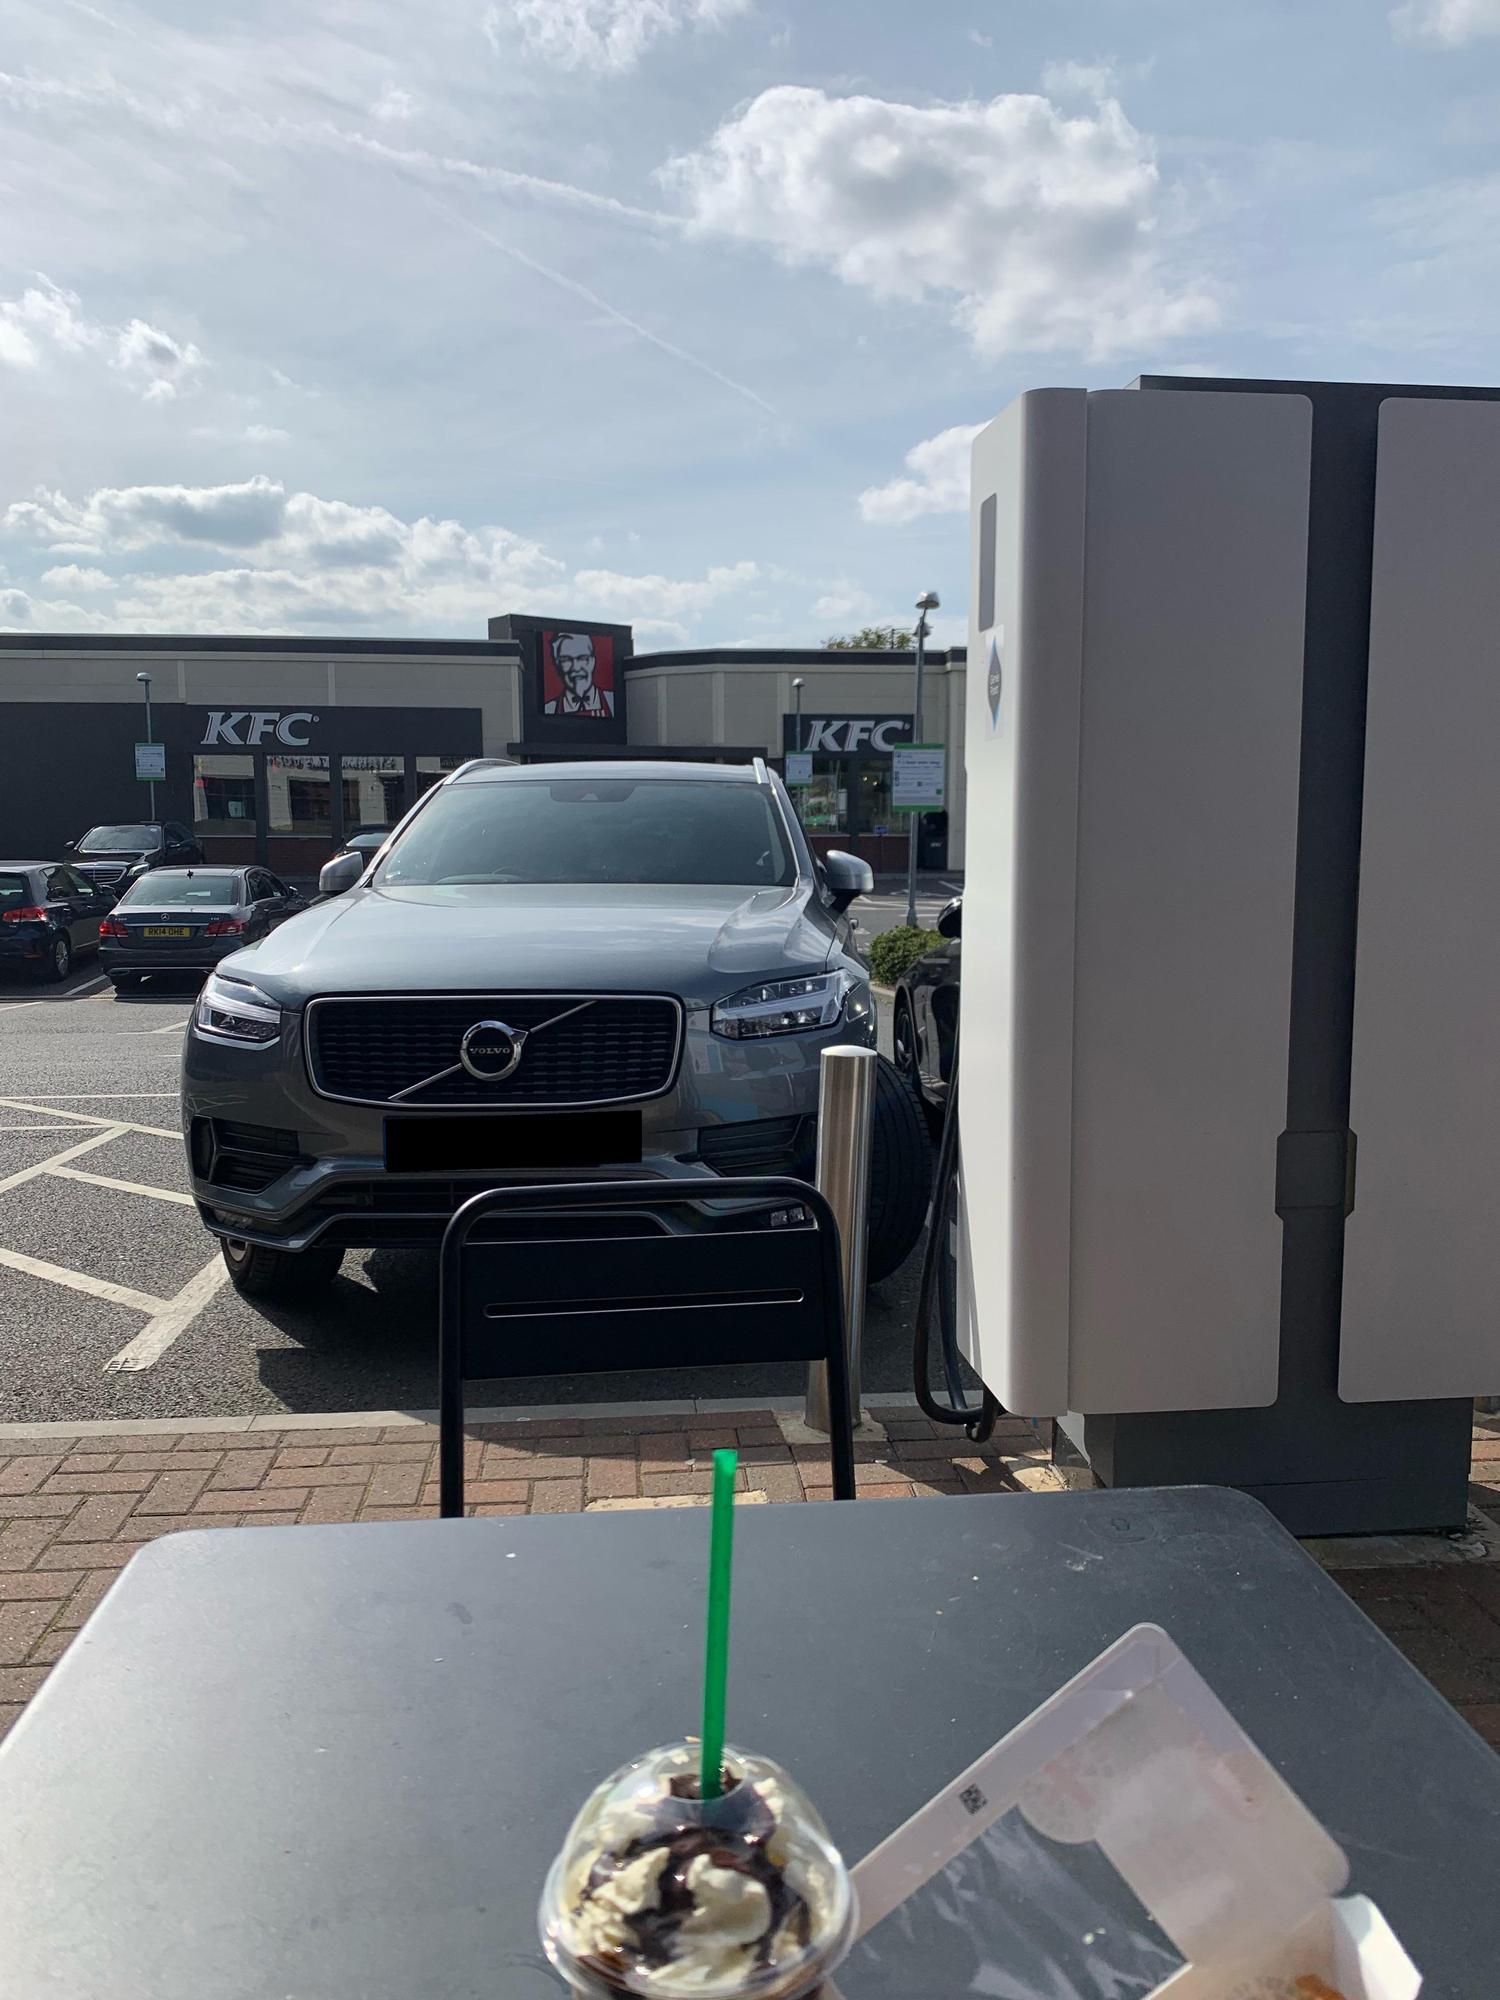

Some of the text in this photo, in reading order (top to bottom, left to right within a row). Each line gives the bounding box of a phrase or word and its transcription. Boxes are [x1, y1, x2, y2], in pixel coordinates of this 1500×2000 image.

[200, 712, 313, 746] KFC
[804, 720, 905, 752] KFC
[469, 1047, 511, 1055] VOLVO
